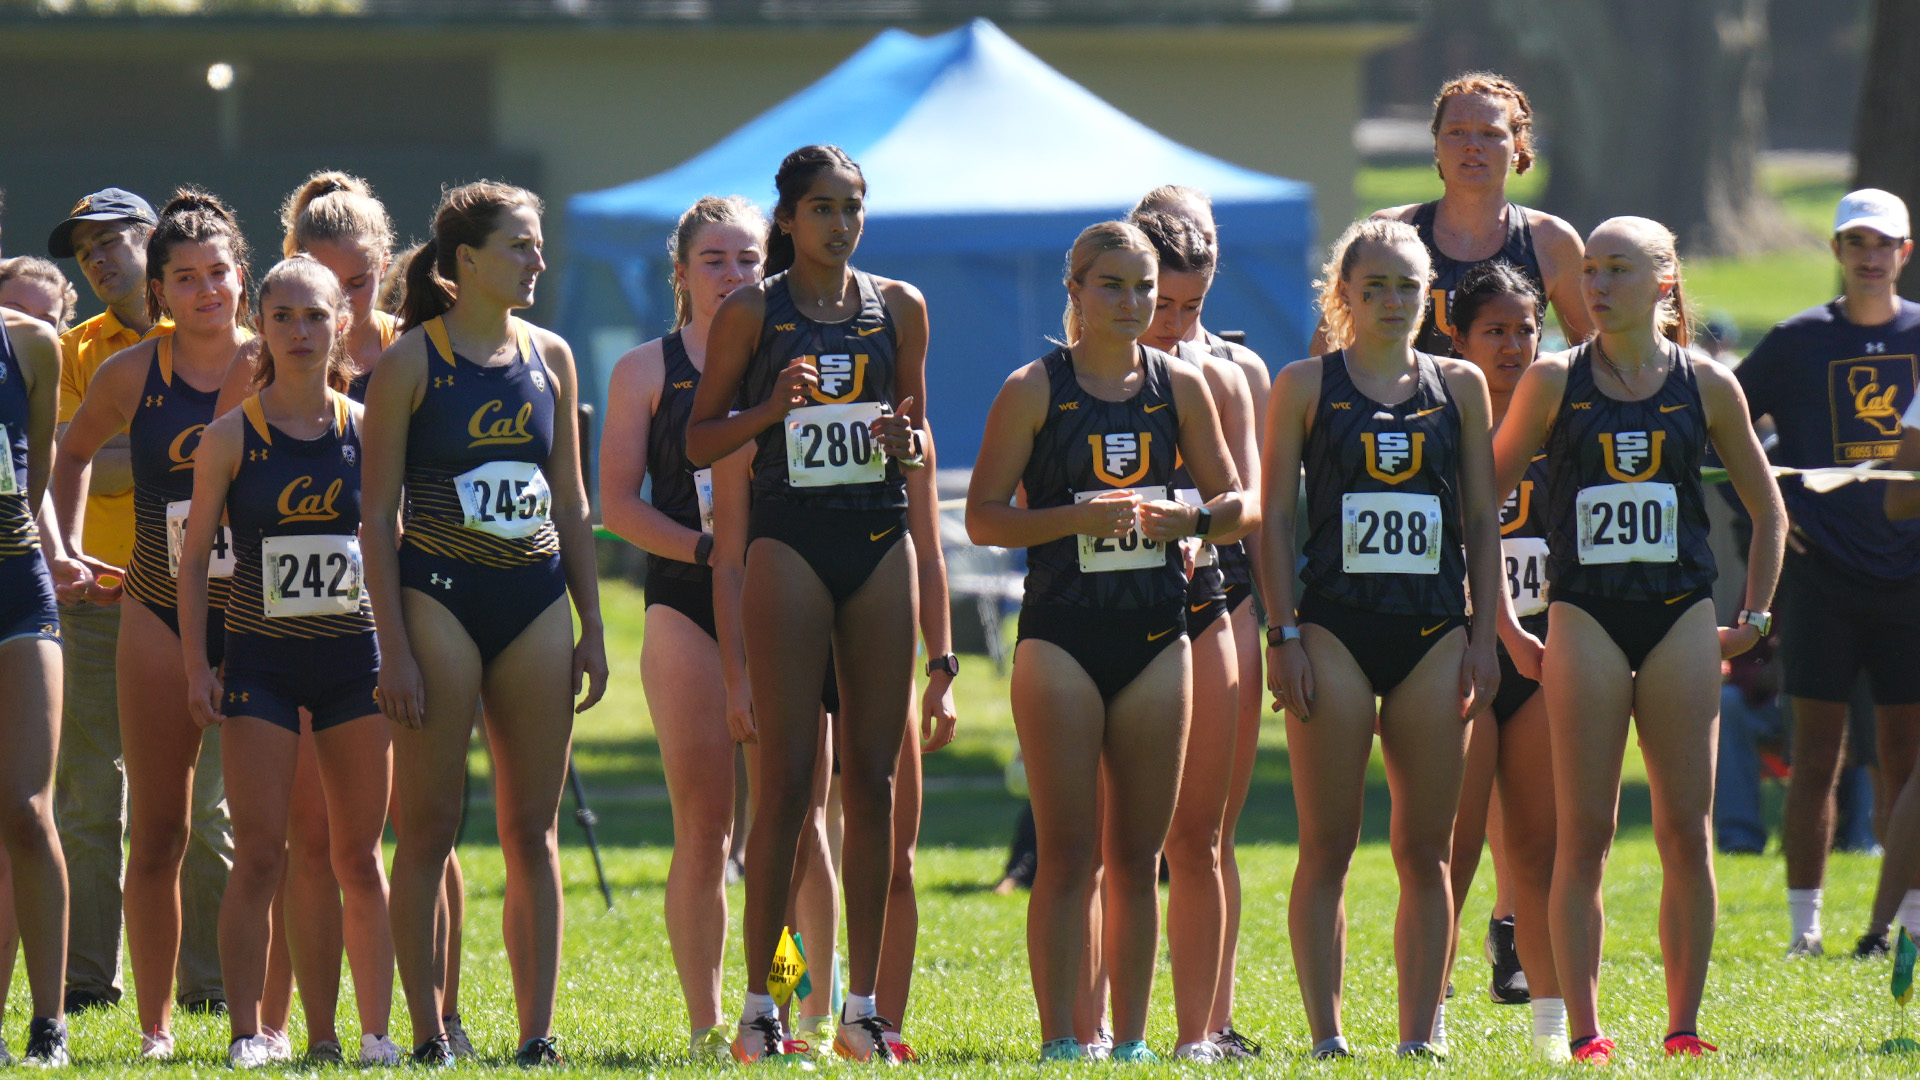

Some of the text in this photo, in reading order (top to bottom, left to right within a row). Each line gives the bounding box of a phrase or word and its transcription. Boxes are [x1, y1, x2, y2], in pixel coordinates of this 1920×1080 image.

[1855, 382, 1898, 419] Cal
[468, 400, 534, 448] Cal
[801, 421, 871, 468] 280
[1873, 444, 1899, 458] COUNT
[277, 475, 343, 525] Cal
[473, 480, 537, 522] 245
[1592, 500, 1662, 545] 290
[1358, 510, 1426, 555] 288
[279, 552, 348, 598] 242
[1506, 556, 1540, 599] 84
[772, 962, 798, 976] OME
